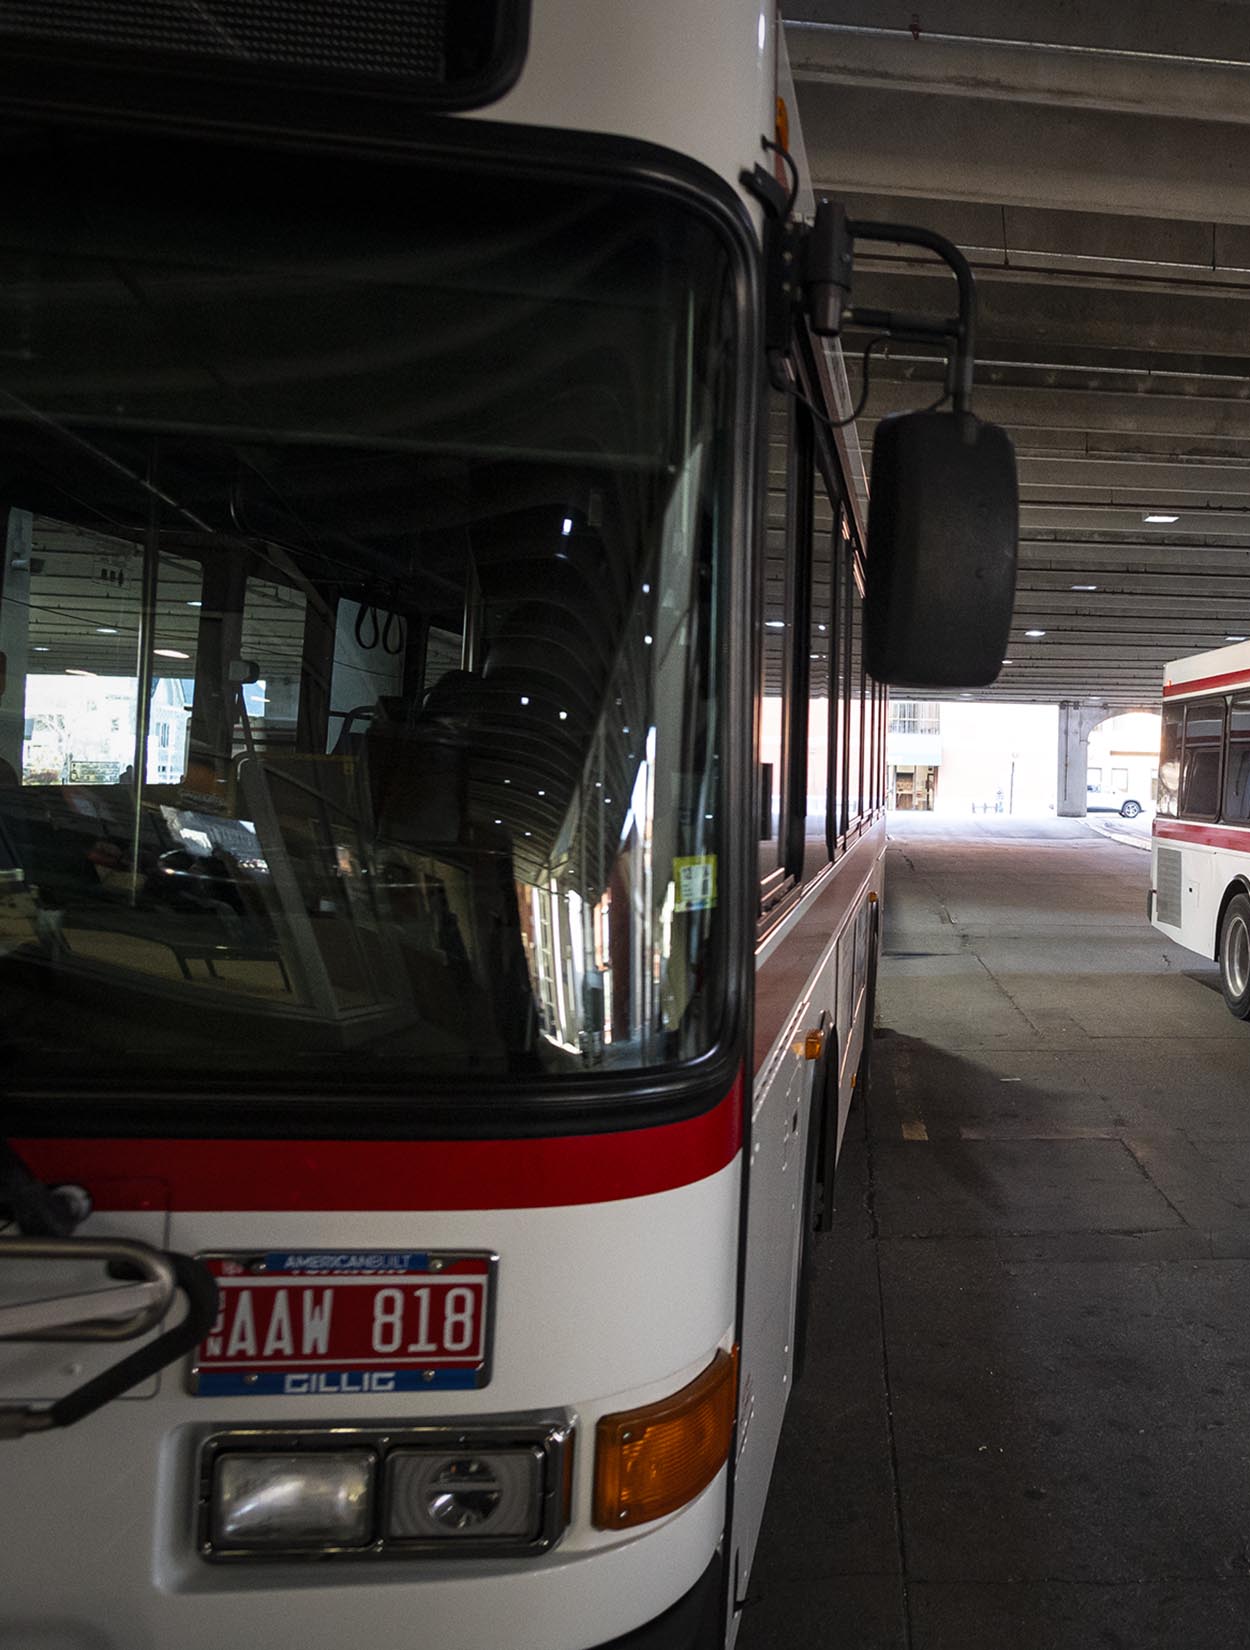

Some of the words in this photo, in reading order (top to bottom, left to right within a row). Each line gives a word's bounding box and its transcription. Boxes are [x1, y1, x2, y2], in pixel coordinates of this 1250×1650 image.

[226, 1288, 334, 1356] AAW
[371, 1287, 475, 1353] 818
[284, 1371, 397, 1393] GILLIG
